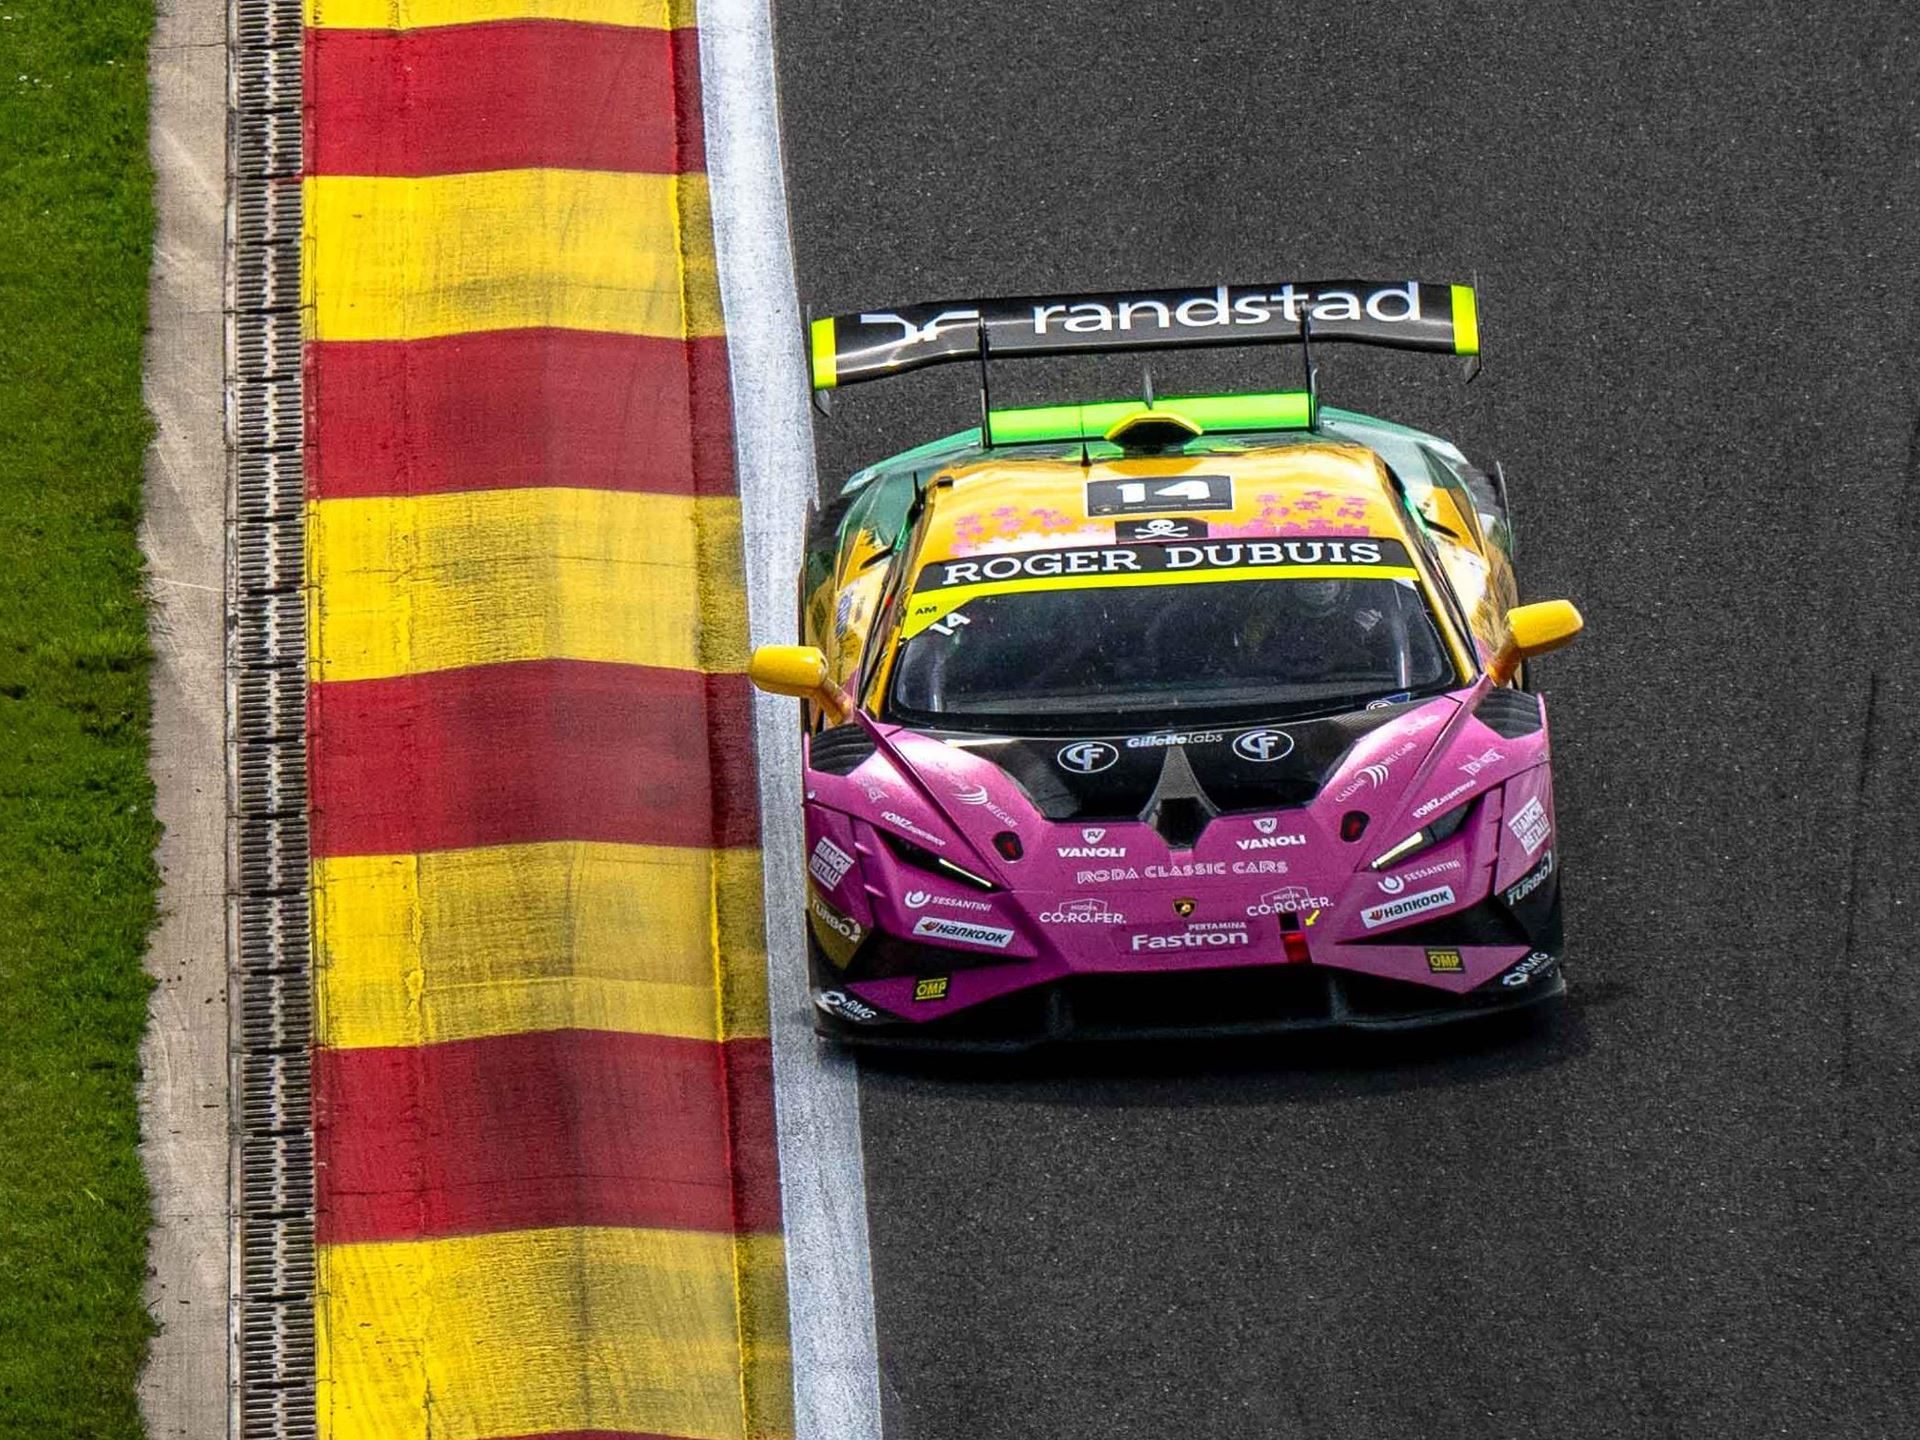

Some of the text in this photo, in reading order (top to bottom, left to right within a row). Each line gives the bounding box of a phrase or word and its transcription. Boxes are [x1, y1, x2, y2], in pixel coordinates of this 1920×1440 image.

[1034, 281, 1421, 334] randstad
[1117, 480, 1211, 503] 14
[942, 541, 1382, 586] ROGER DUBUIS
[915, 605, 938, 615] AM
[1236, 834, 1307, 850] VANOLI
[1057, 847, 1127, 858] VANOLI
[1077, 860, 1289, 885] RODA CLASSIC CARS
[931, 896, 993, 912] SESSANTINI
[1188, 921, 1247, 931] PERTAMINA
[1131, 931, 1249, 951] Fastron
[1430, 953, 1460, 968] OMP
[916, 981, 947, 996] OMP
